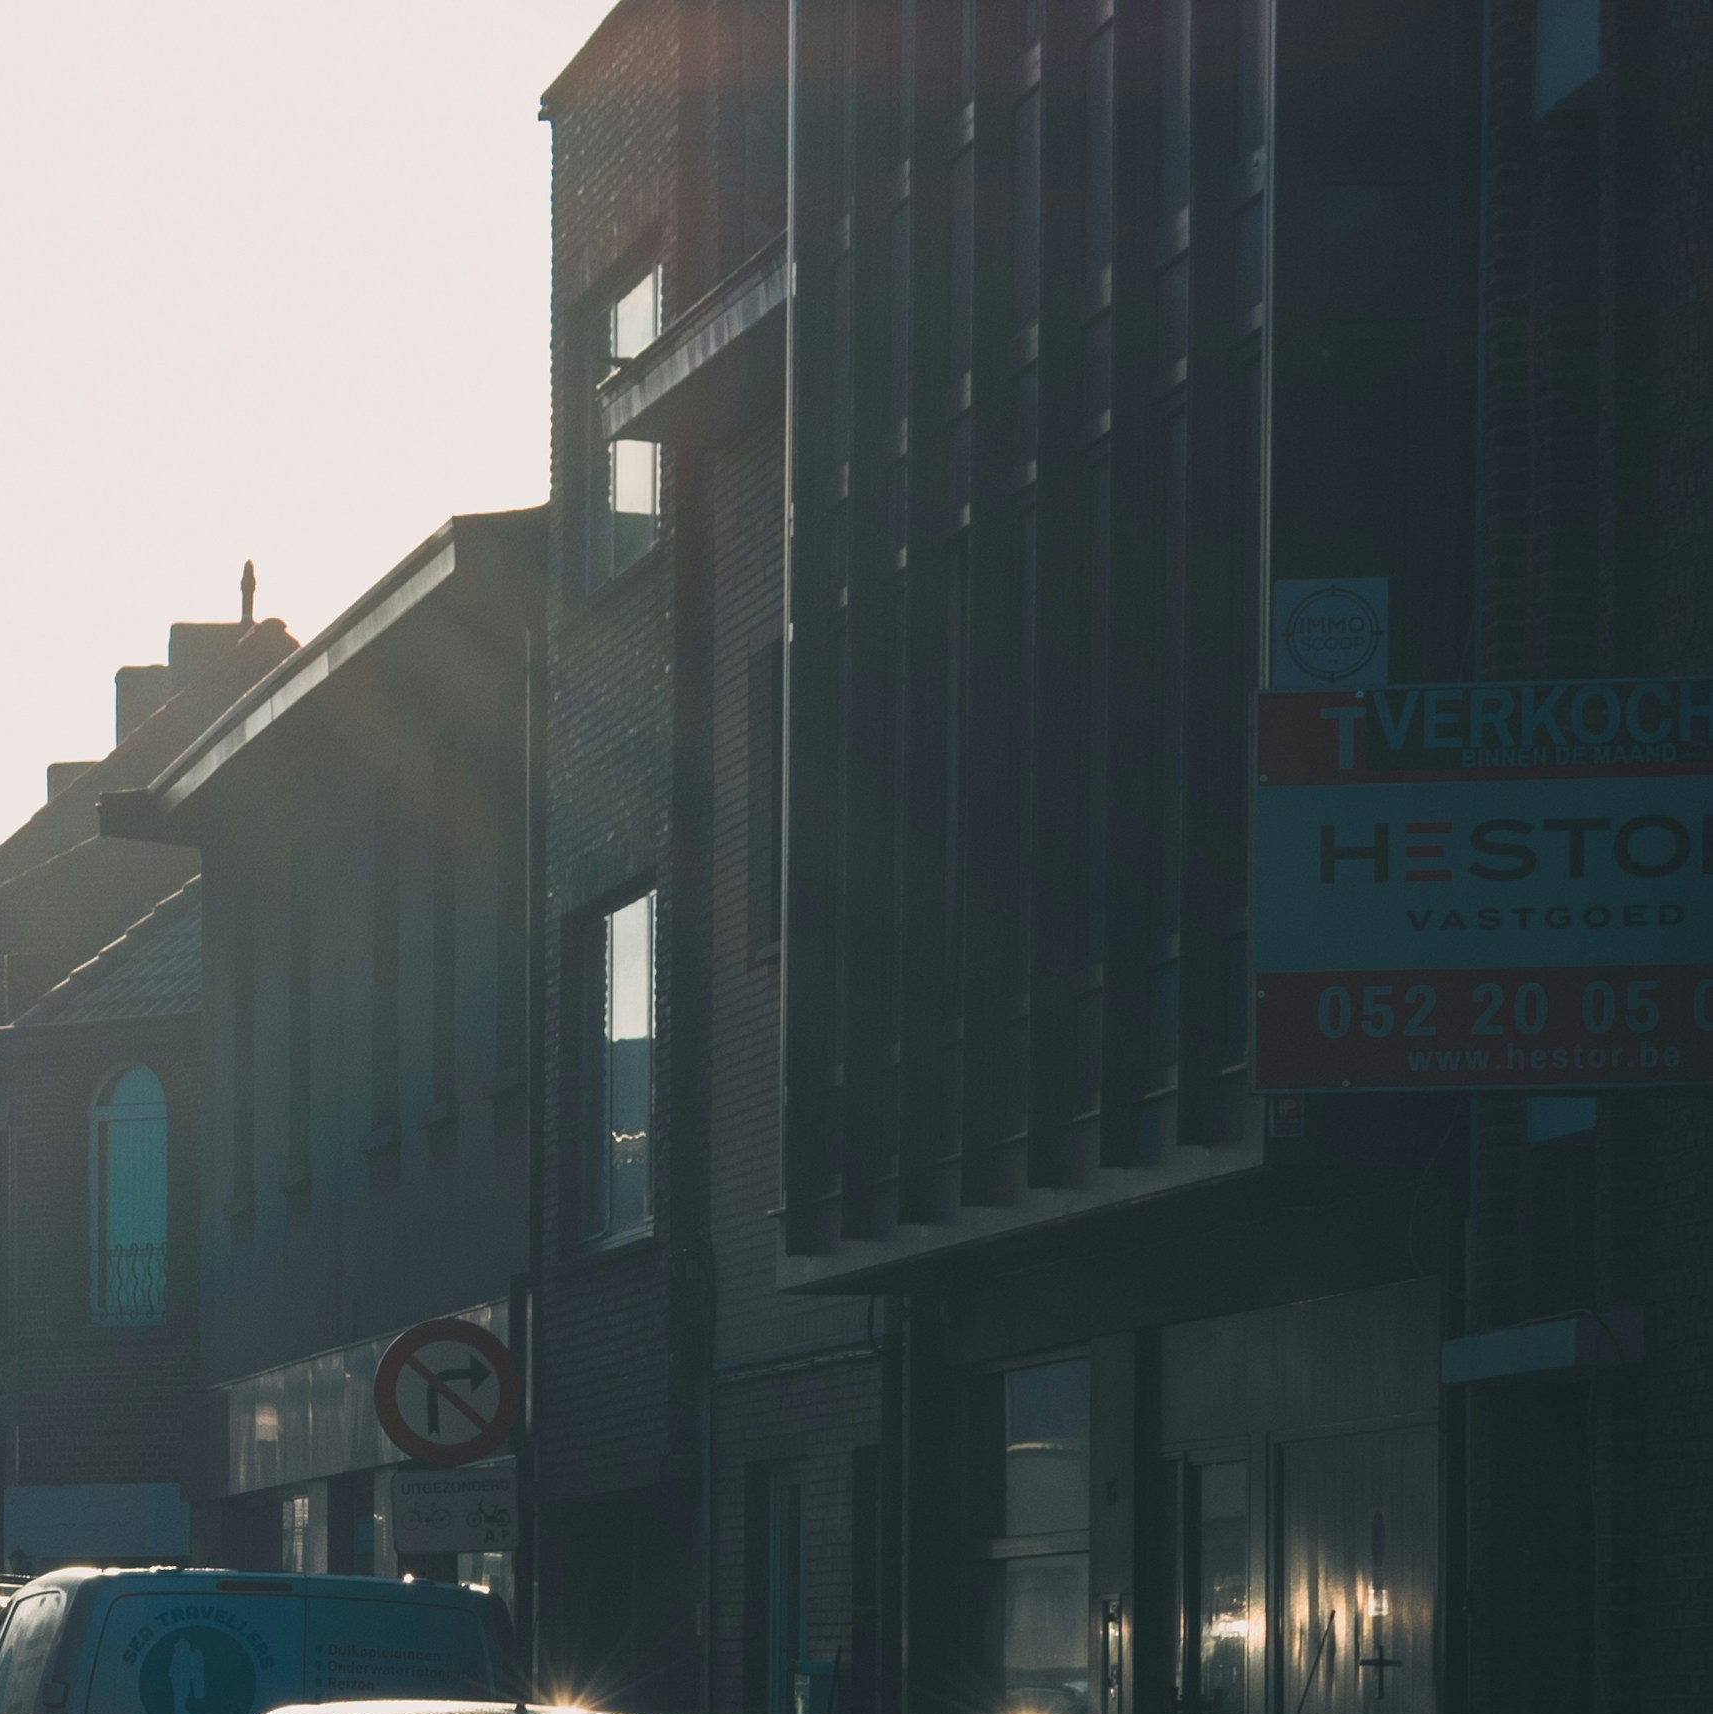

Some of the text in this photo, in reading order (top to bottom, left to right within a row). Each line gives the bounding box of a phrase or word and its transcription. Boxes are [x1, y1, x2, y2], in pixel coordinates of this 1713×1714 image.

[1299, 615, 1366, 634] IMMO
[1300, 635, 1366, 653] SCOOP
[1461, 743, 1678, 769] BINNEN DE MAAND
[1319, 814, 1713, 885] HESTO
[1407, 903, 1687, 932] VASTGOED
[1318, 984, 1438, 1039] 052
[1471, 981, 1549, 1036] 20
[1582, 980, 1660, 1034] 05
[1407, 1041, 1682, 1072] www.hestor.be
[401, 1480, 510, 1495] UITGEZONDERD
[122, 1605, 276, 1670] SEA TRAVELLERS
[328, 1643, 442, 1662] Duikopleidingen
[328, 1677, 375, 1691] Reizen
